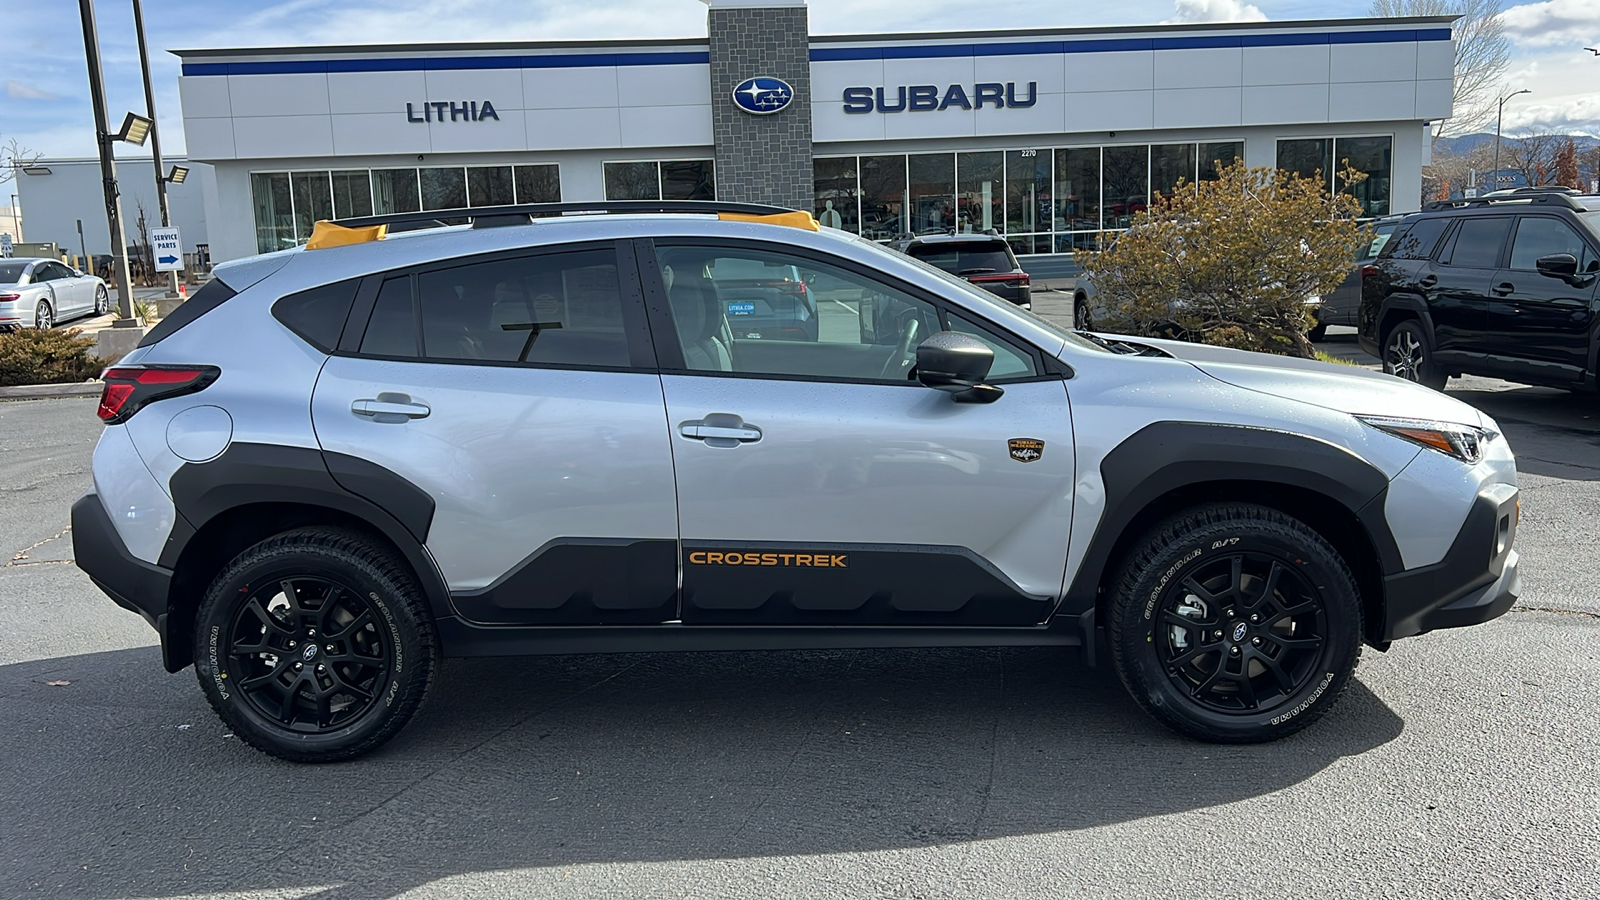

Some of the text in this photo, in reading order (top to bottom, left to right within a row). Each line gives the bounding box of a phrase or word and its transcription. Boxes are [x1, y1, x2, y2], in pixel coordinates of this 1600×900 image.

[406, 100, 499, 123] LITHIA
[843, 81, 1037, 114] SUBARU
[1021, 149, 1037, 157] 2270
[689, 551, 848, 568] CROSSTREK
[1144, 537, 1241, 621] GEOLANDAR A/T
[368, 591, 405, 673] GEOLANDAR
[207, 625, 231, 701] YOKOHAMA
[1270, 672, 1335, 726] YOKOHAMA
